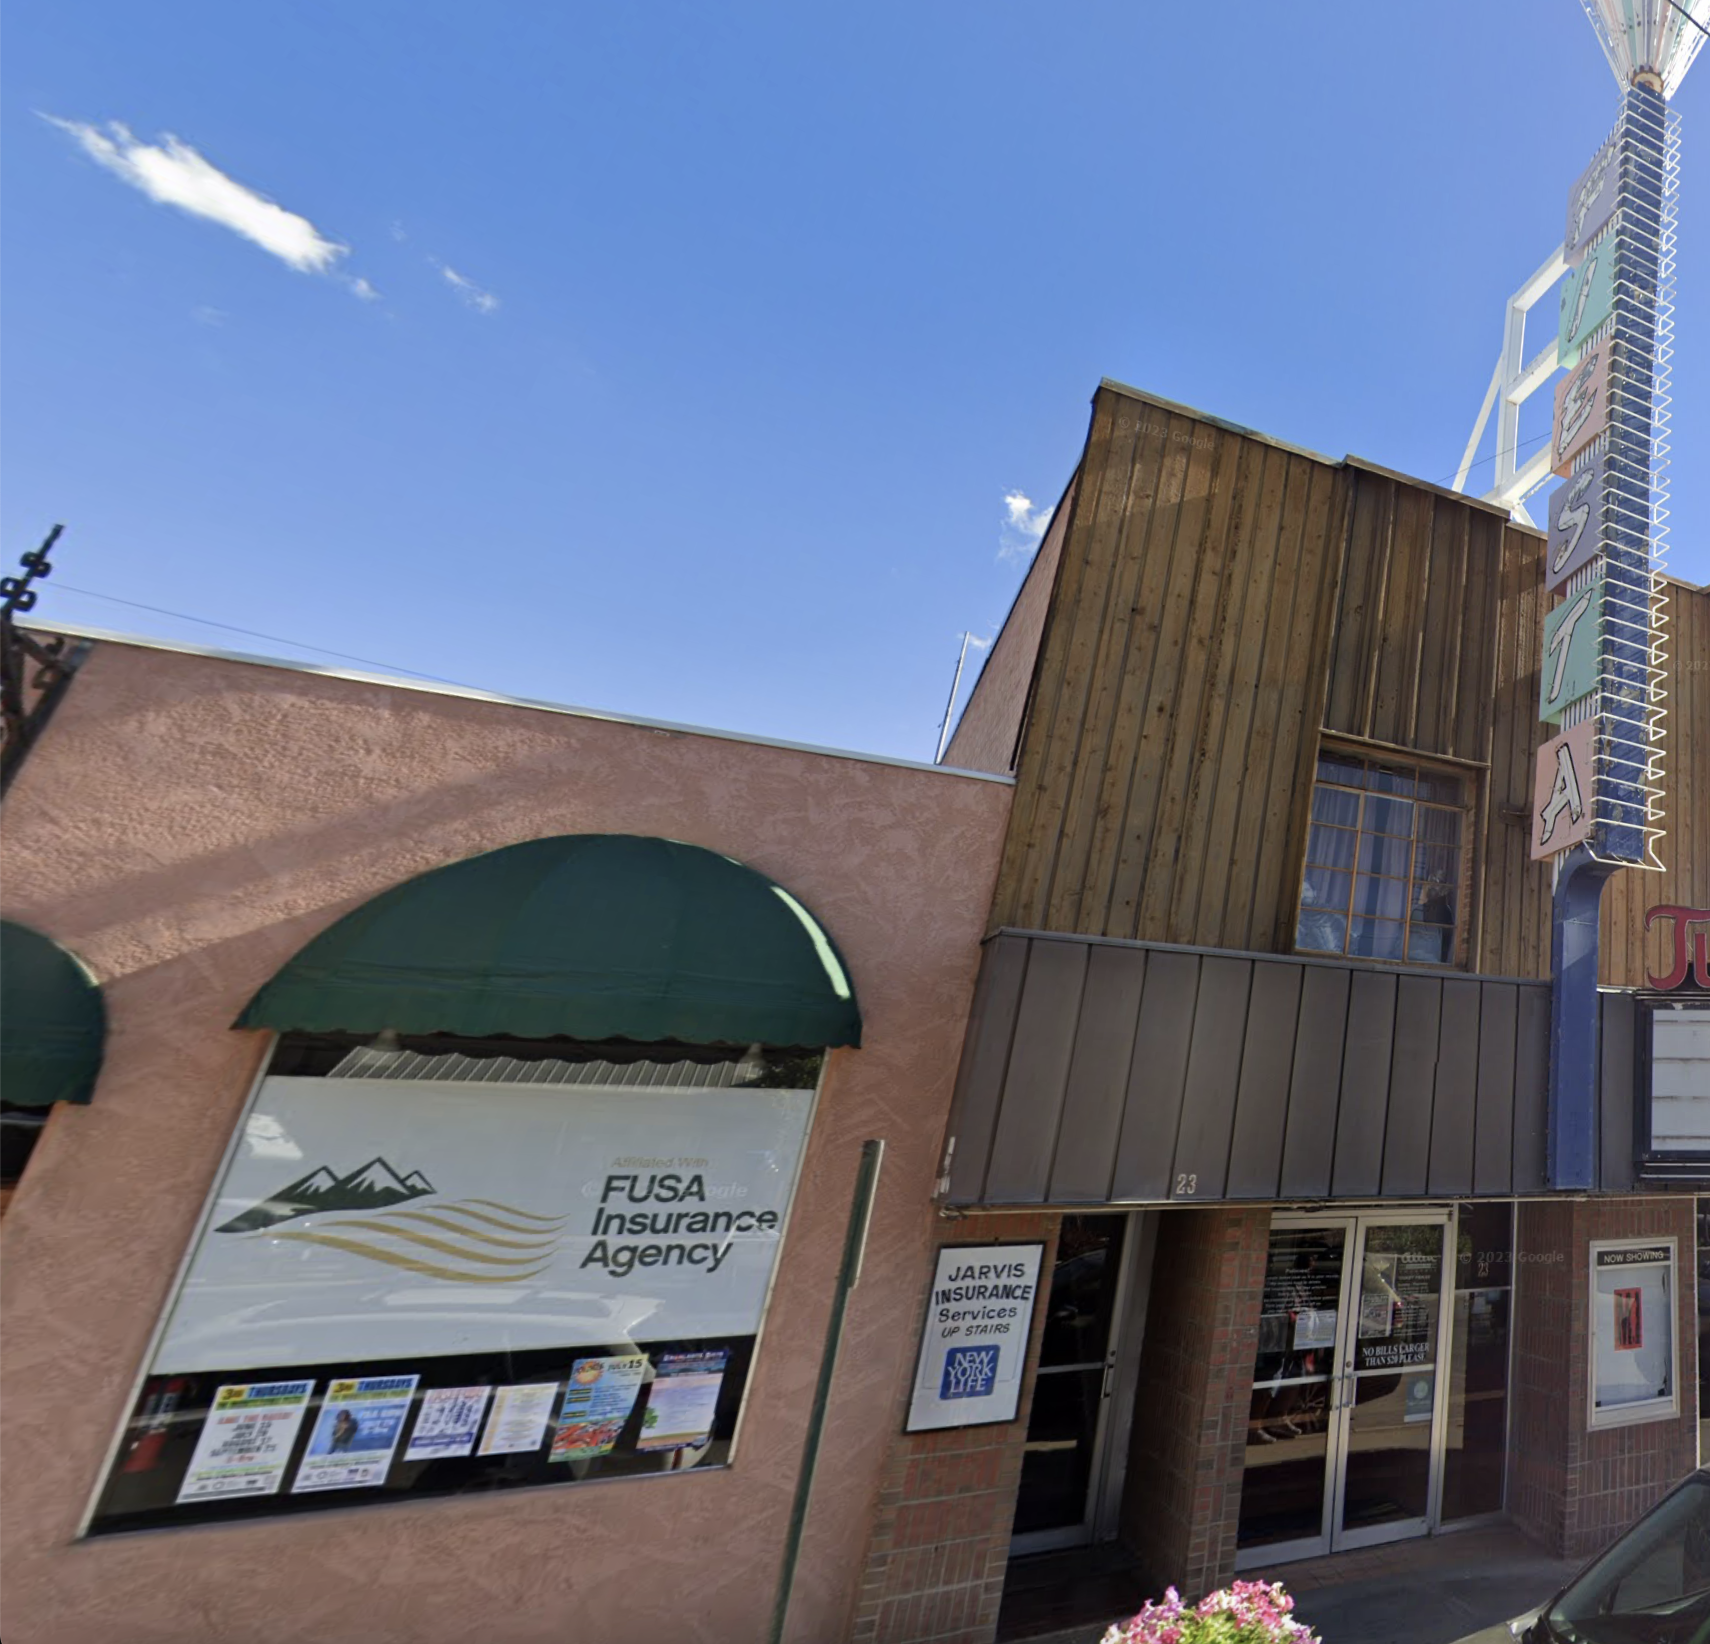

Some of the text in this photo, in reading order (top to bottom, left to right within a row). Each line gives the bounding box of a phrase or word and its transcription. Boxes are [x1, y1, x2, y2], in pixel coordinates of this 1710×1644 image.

[1537, 142, 1617, 846] FIESTA
[600, 1174, 706, 1203] FUSA
[1176, 1174, 1197, 1194] 23
[591, 1207, 779, 1236] Insurance
[579, 1239, 734, 1278] Agency
[1603, 1251, 1664, 1263] NOW SHOWING
[948, 1263, 1025, 1282] JARVIS
[1477, 1262, 1489, 1278] 23
[935, 1284, 1033, 1306] INSURANCE
[938, 1306, 1017, 1323] Services
[941, 1323, 1010, 1339] UP STAIRS
[1362, 1342, 1430, 1357] NO BILLS LARGER
[955, 1350, 994, 1367] NEW
[1365, 1356, 1387, 1367] THAN
[947, 1362, 994, 1379] YORK
[950, 1378, 986, 1393] LIFE
